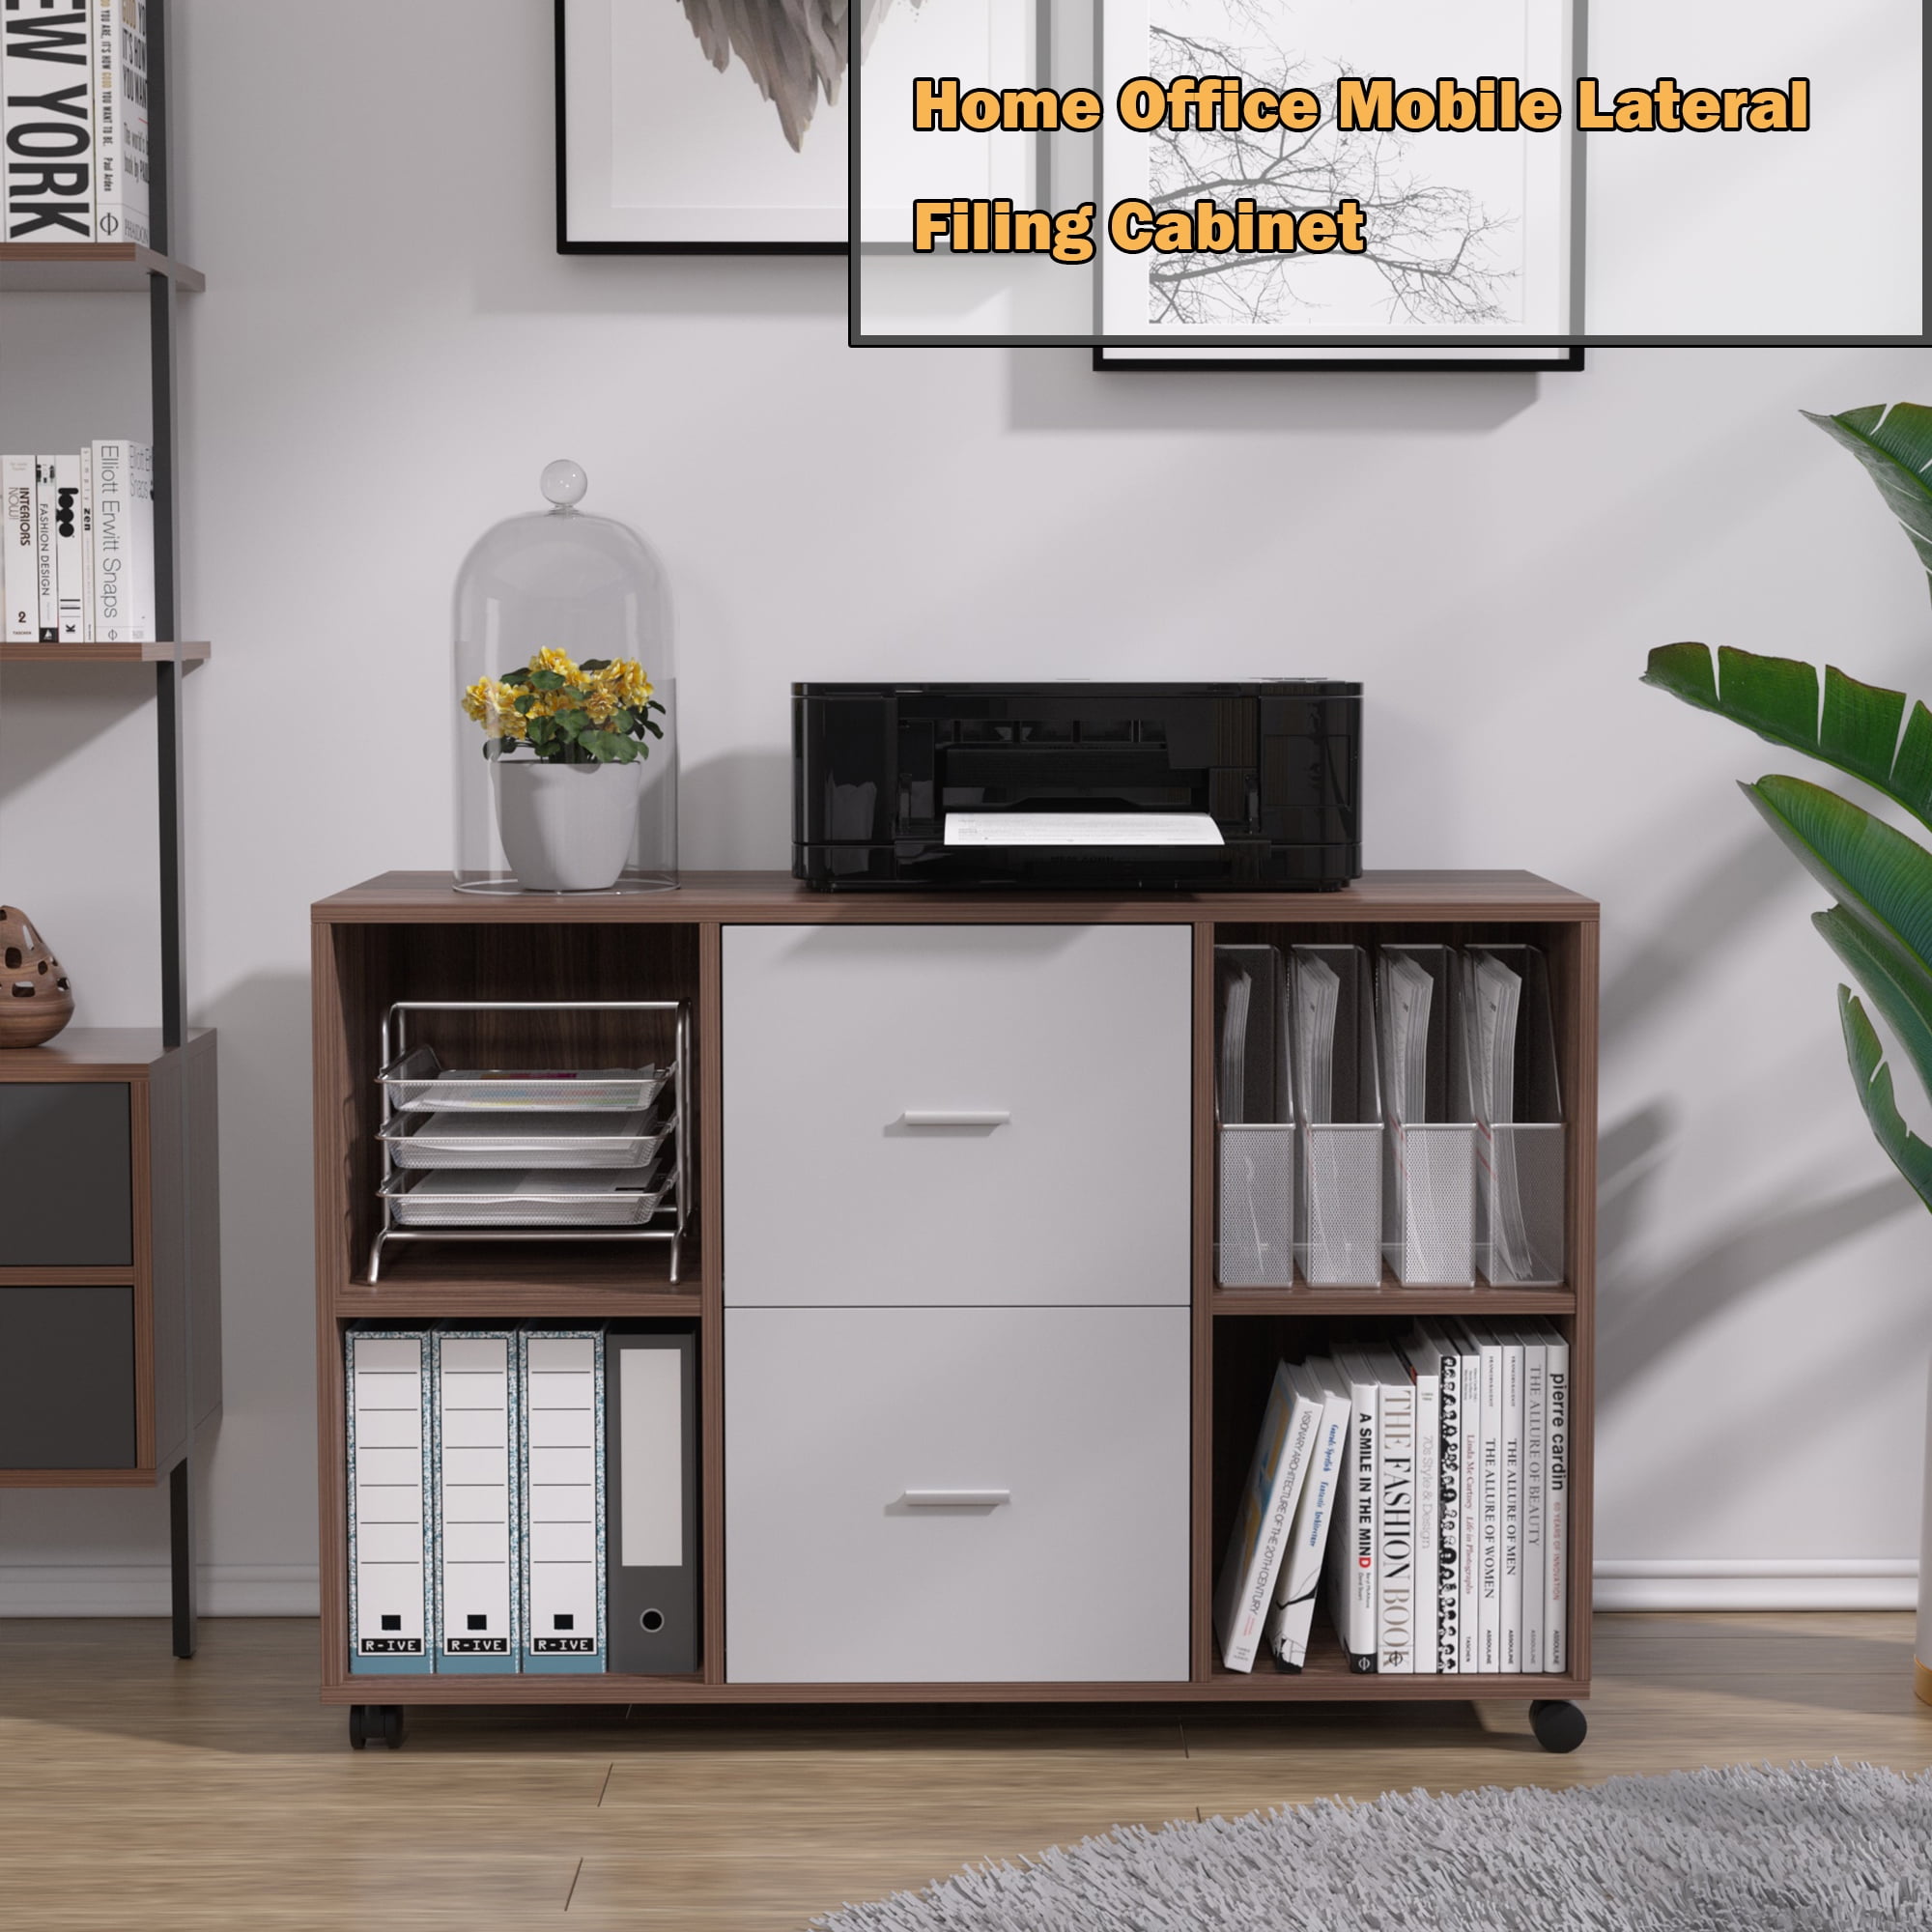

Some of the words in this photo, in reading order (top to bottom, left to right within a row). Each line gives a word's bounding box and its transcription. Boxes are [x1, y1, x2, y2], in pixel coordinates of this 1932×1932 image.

[100, 10, 111, 22] YOU
[101, 55, 112, 70] HOW
[102, 91, 112, 103] YOU
[103, 106, 113, 124] WANT
[7, 83, 91, 240] YORK
[103, 157, 113, 171] Paul
[103, 174, 113, 191] Arden
[100, 445, 120, 494] Elliott
[8, 487, 20, 520] NOW!
[19, 487, 30, 547] INTERIORS
[83, 508, 94, 531] zen
[40, 503, 49, 551] FASHION
[100, 500, 121, 552] Erwitt
[40, 554, 50, 596] DESIGN
[100, 557, 122, 618] Snaps
[18, 611, 27, 623] 2
[1529, 1364, 1542, 1396] THE
[1549, 1374, 1567, 1427] pierre
[1294, 1410, 1313, 1451] VISIONARY
[1359, 1412, 1372, 1423] A
[1384, 1390, 1411, 1449] THE
[1529, 1400, 1542, 1459] ALLURE
[1359, 1428, 1372, 1472] SMILE
[1466, 1435, 1475, 1460] Linda
[1485, 1438, 1495, 1466] THE
[1507, 1438, 1518, 1466] THE
[1550, 1434, 1567, 1491] cardin
[1276, 1450, 1303, 1514] ARCHITECTURE
[1359, 1478, 1372, 1492] IN
[1420, 1456, 1434, 1484] Style
[1529, 1462, 1542, 1483] OF
[1464, 1474, 1475, 1509] Cartney
[1485, 1469, 1495, 1521] ALLURE
[1507, 1469, 1518, 1521] ALLURE
[1272, 1514, 1284, 1527] OF
[1359, 1497, 1372, 1523] THE
[1383, 1457, 1411, 1580] FASHION
[1420, 1503, 1434, 1548] Design
[1528, 1485, 1542, 1547] BEAUTY
[1266, 1526, 1282, 1545] THE
[1359, 1528, 1372, 1568] MIND
[1485, 1524, 1495, 1544] OF
[1507, 1524, 1517, 1544] OF
[1553, 1541, 1561, 1550] OF
[1261, 1546, 1278, 1570] 20TH
[1463, 1544, 1475, 1595] Photographs
[1485, 1545, 1495, 1599] WOMEN
[1507, 1545, 1517, 1576] MEN
[1249, 1568, 1271, 1615] CENTURY
[1552, 1553, 1561, 1601] INNOVATION
[1382, 1588, 1410, 1667] BOOK
[365, 1640, 416, 1651] R-IVE
[451, 1640, 502, 1651] R-IVE
[538, 1639, 588, 1650] R-IVE
